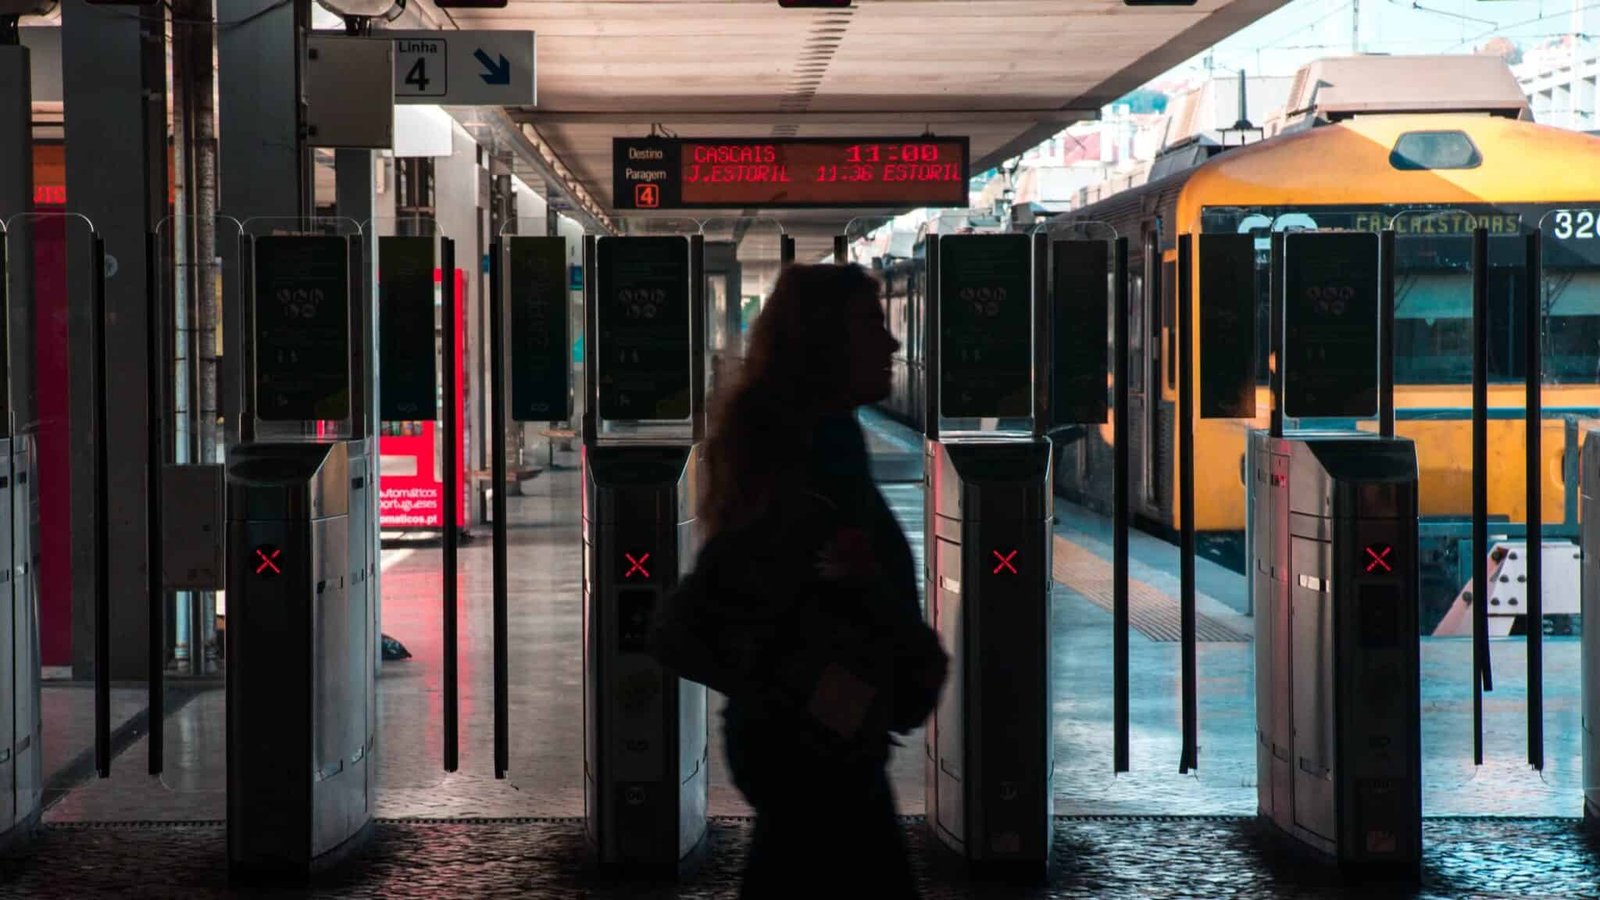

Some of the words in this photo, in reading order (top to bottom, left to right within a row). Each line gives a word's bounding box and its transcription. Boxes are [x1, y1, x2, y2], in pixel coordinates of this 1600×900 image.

[399, 41, 438, 54] Linha
[405, 57, 430, 91] 4
[629, 147, 663, 160] Destino
[694, 145, 775, 163] CASCAIS
[847, 144, 939, 163] 11:00
[625, 168, 667, 182] Paragem
[882, 164, 961, 182] ESTORIL
[640, 187, 654, 205] 4
[1554, 211, 1600, 239] 32
